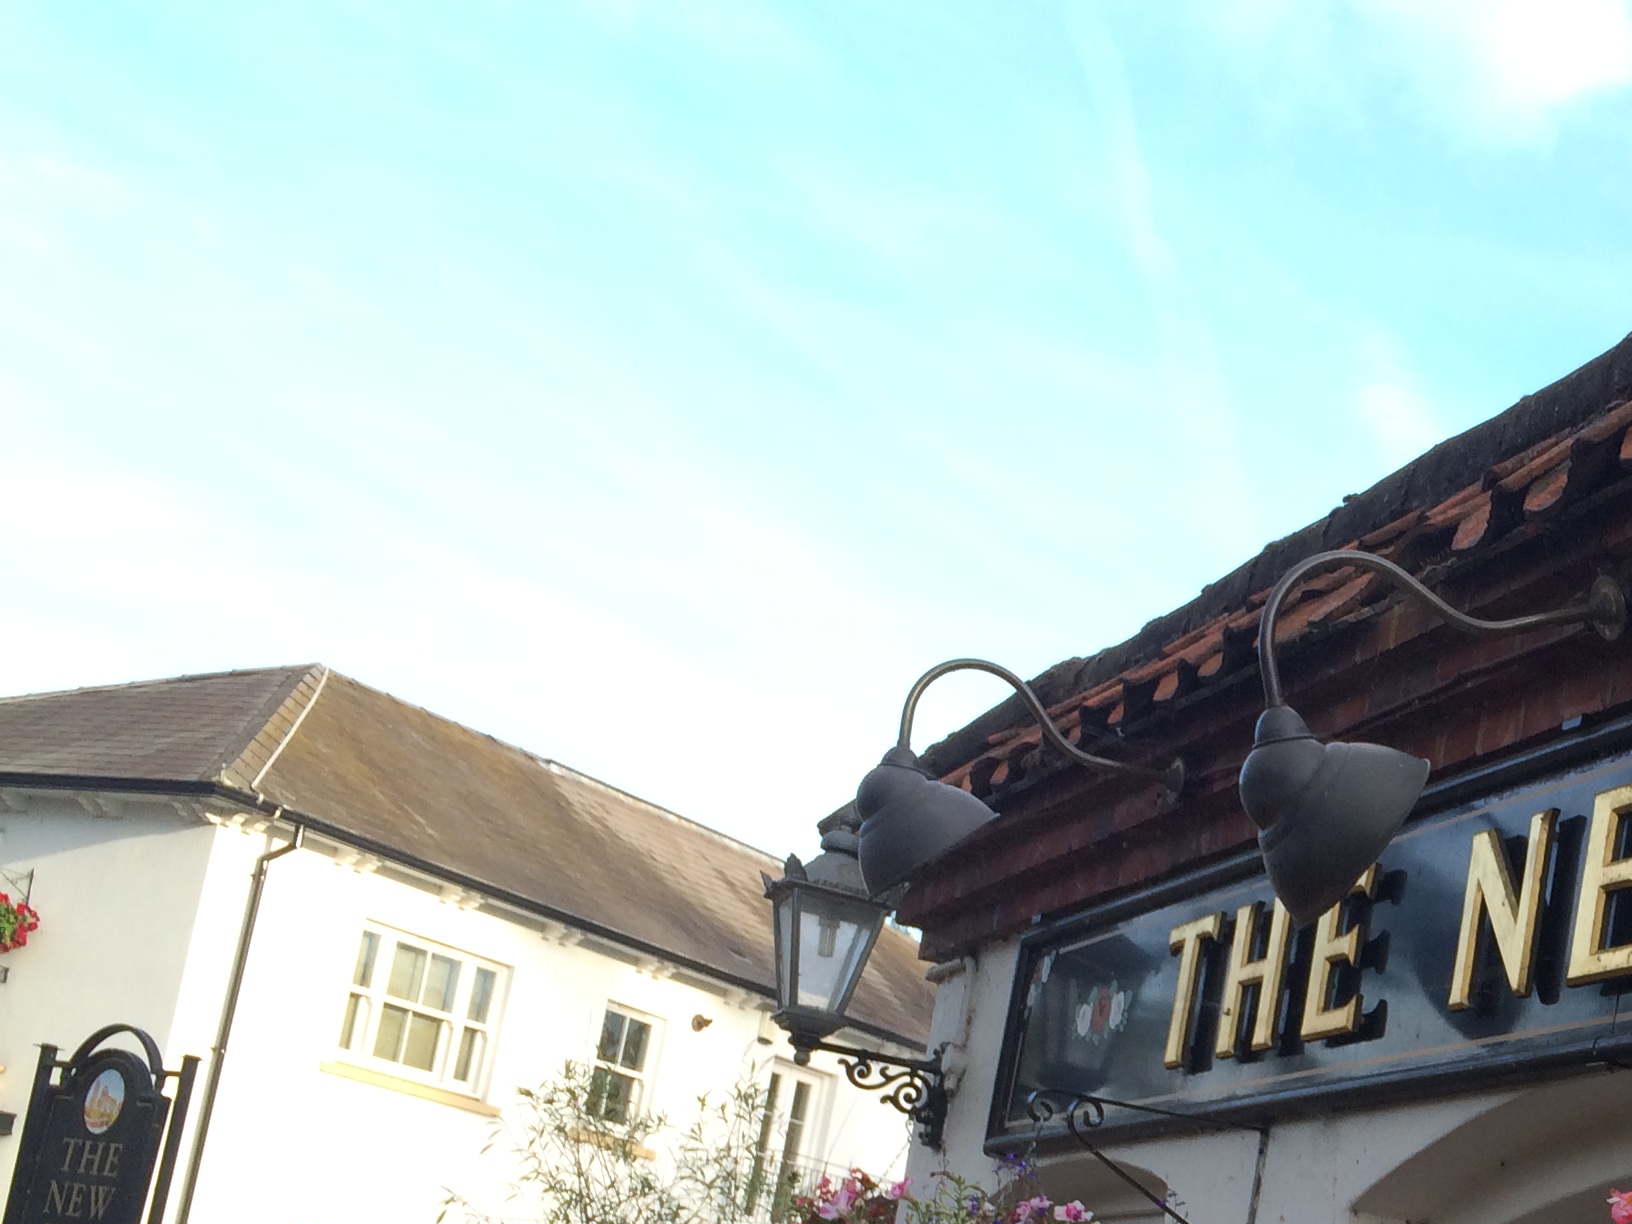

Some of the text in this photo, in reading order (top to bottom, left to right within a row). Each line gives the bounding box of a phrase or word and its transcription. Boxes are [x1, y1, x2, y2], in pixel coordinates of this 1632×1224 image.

[1163, 862, 1382, 1070] THE
[60, 1136, 124, 1178] THE
[42, 1179, 117, 1220] NEW
